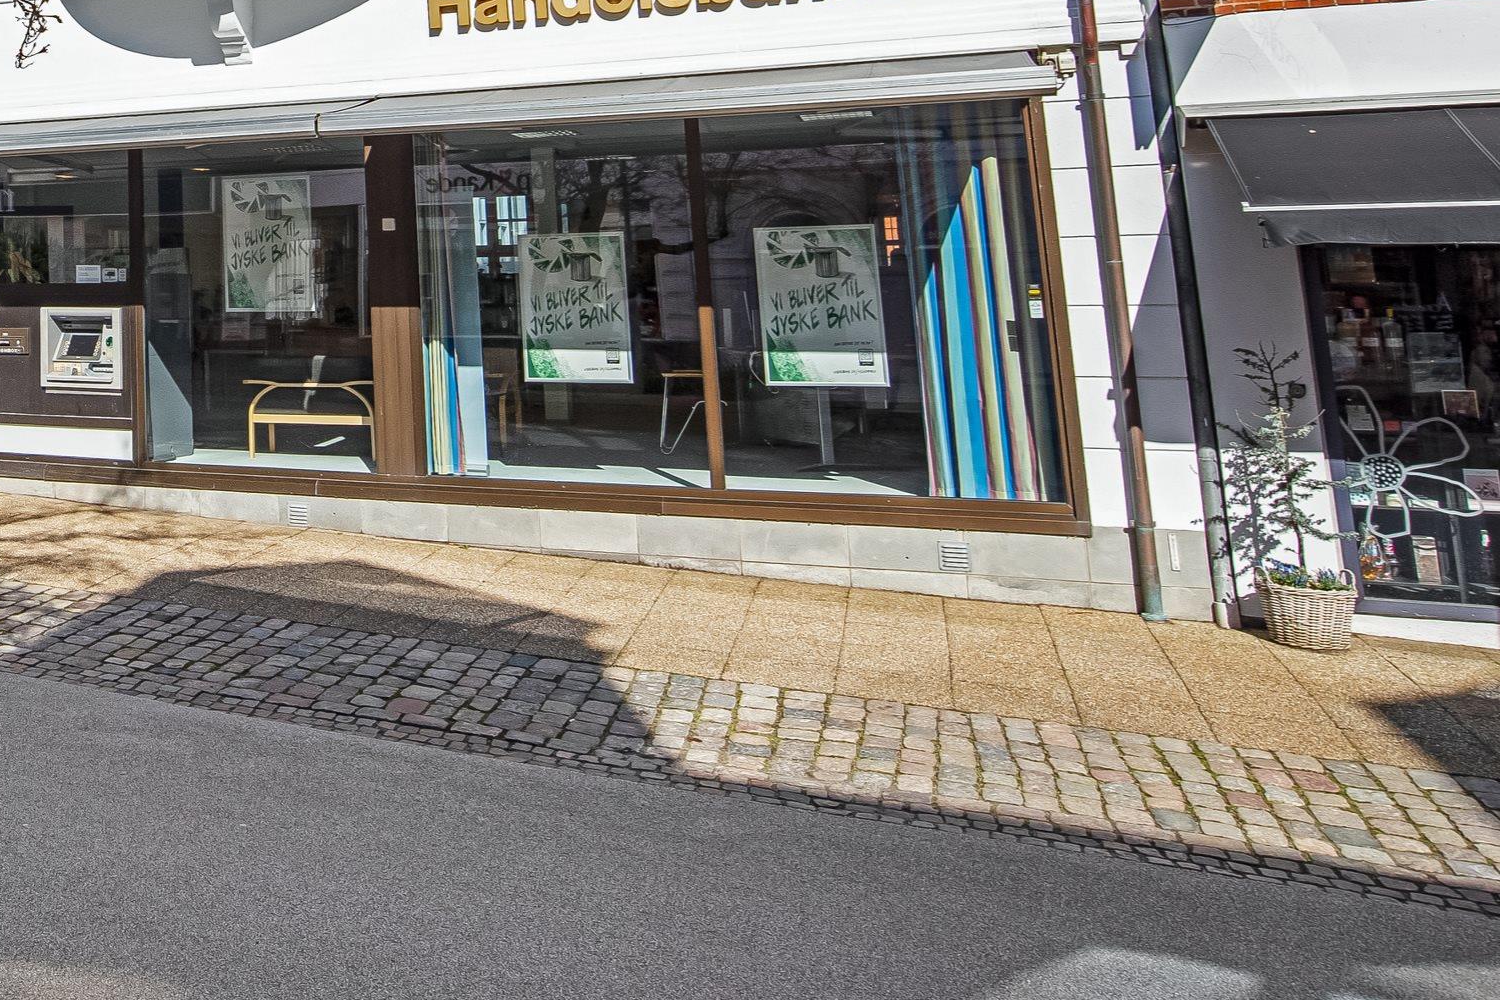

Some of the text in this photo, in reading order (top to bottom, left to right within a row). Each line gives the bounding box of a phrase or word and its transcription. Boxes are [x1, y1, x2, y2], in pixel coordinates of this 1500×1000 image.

[232, 218, 300, 249] VI BLIVER TIL
[231, 238, 309, 270] JYSKE BANK
[530, 280, 613, 313] VI BLIVER TIL
[770, 276, 865, 312] VI BLIVER TIL
[530, 301, 624, 336] JYSKE BANK
[770, 299, 877, 337] JYSKE BANK
